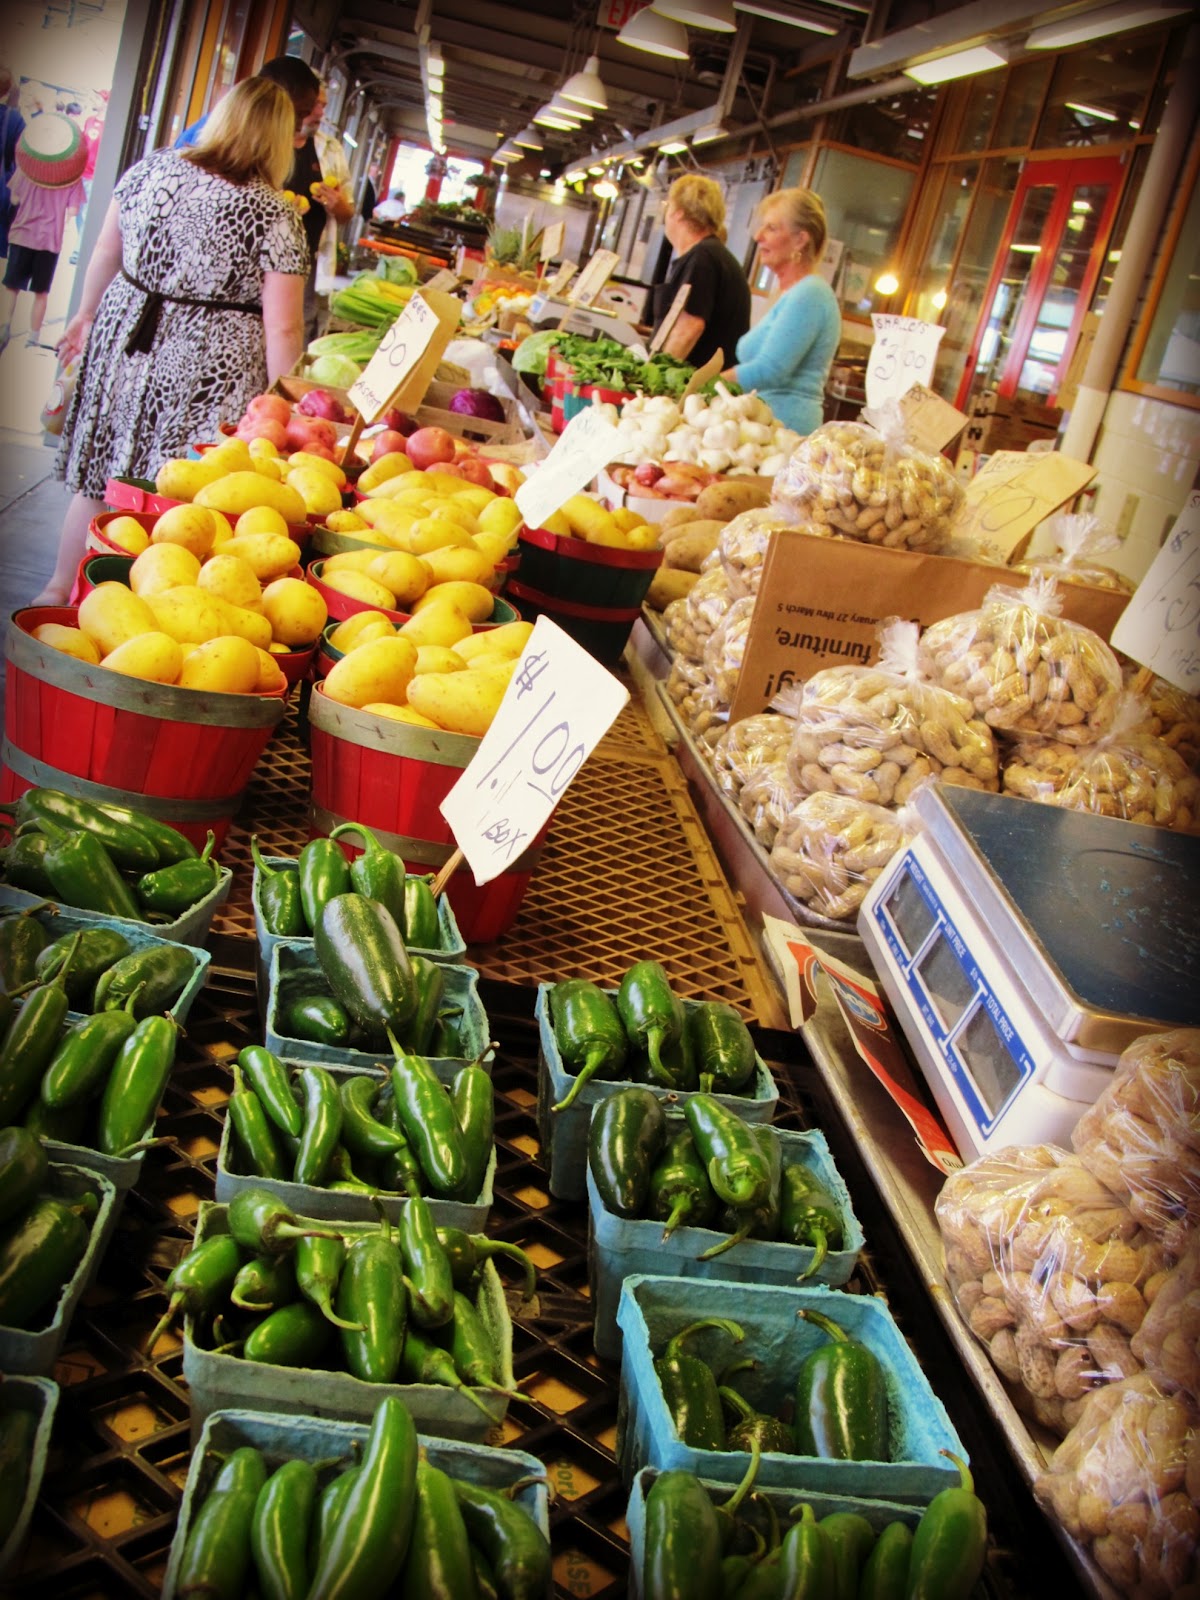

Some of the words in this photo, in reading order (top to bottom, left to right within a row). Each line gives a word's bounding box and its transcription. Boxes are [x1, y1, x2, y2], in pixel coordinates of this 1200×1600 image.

[776, 602, 784, 612] 5
[786, 604, 815, 617] March
[816, 609, 835, 621] thru
[836, 612, 849, 623] 27
[776, 627, 871, 664] furniture,
[944, 921, 957, 940] UNIT
[952, 934, 967, 958] PRICE
[986, 994, 1001, 1022] TOTAL
[997, 1013, 1015, 1043] PRICE
